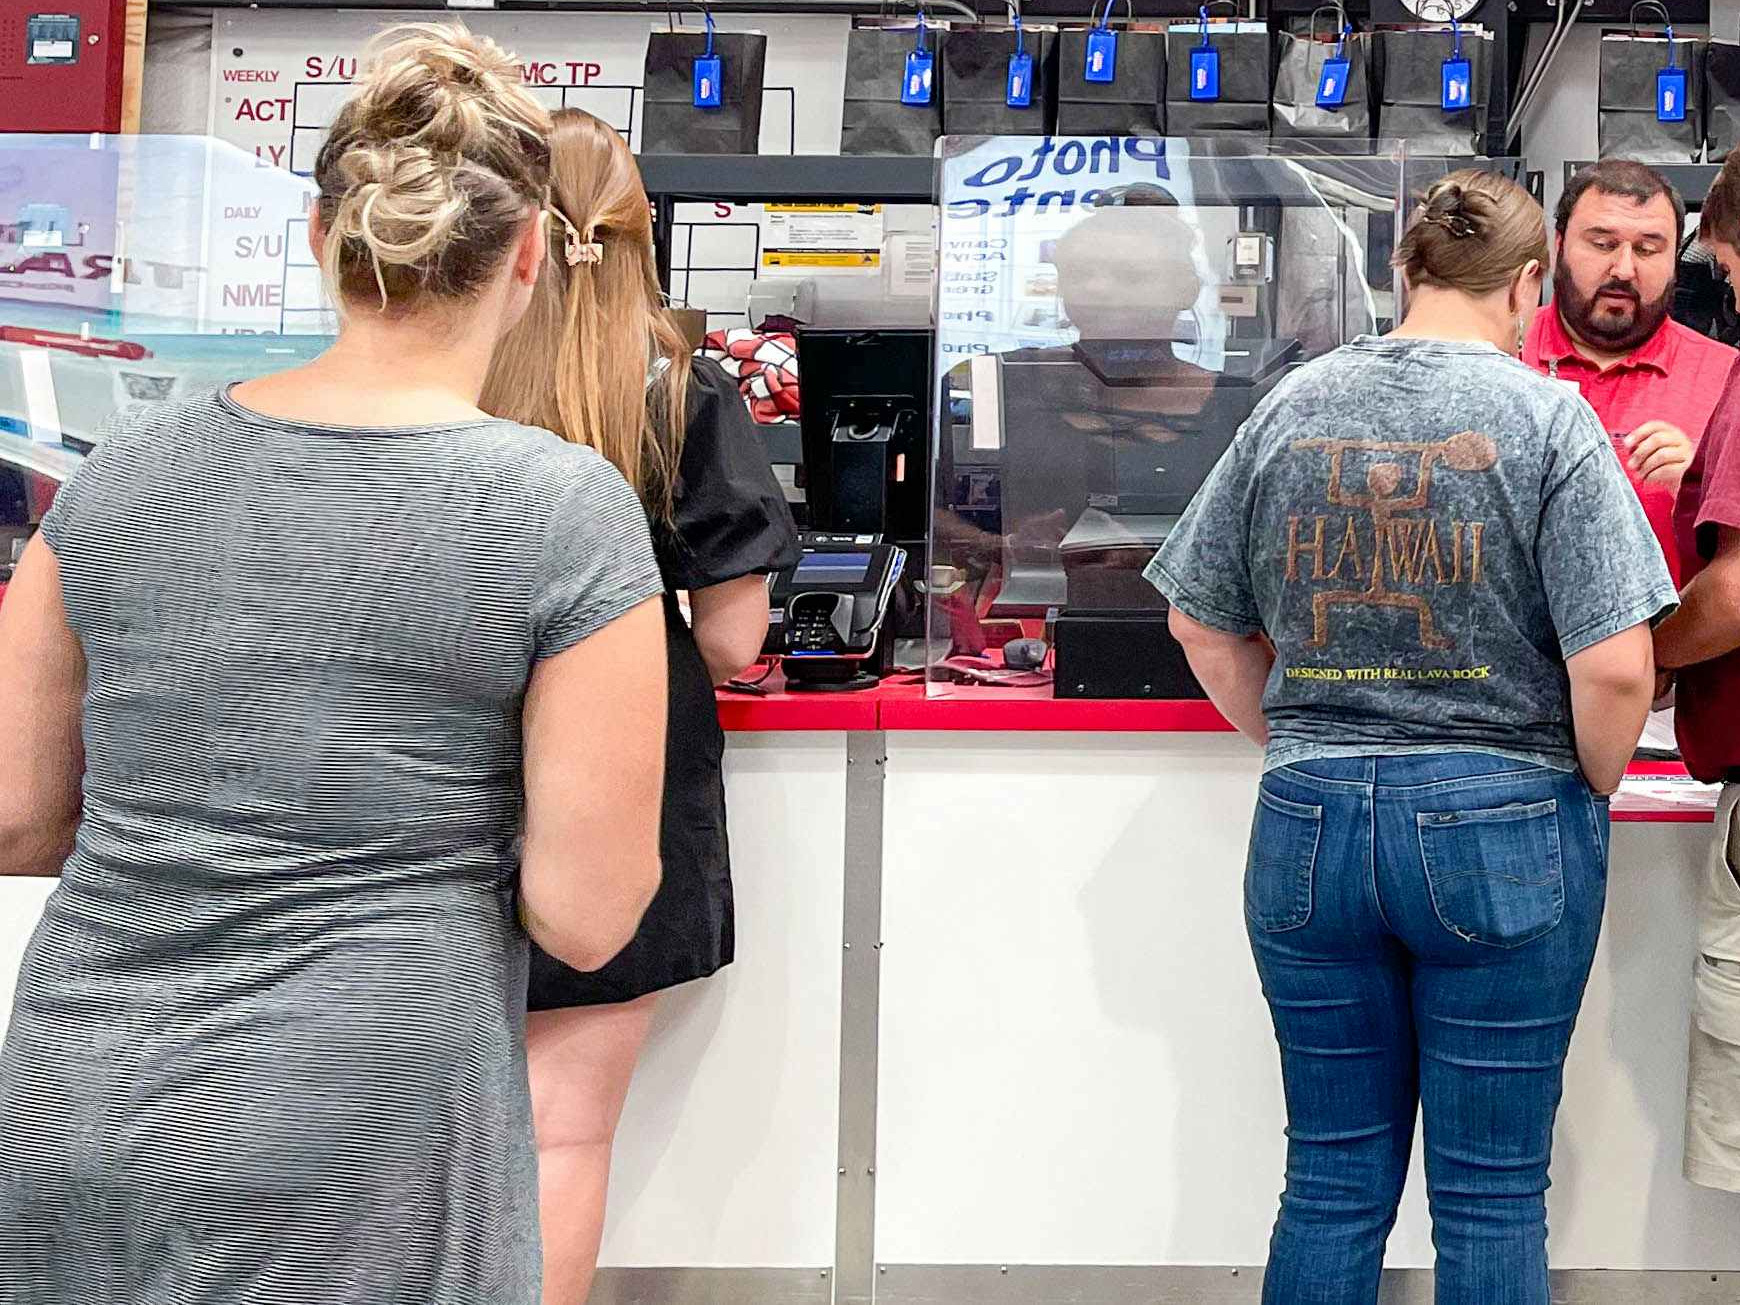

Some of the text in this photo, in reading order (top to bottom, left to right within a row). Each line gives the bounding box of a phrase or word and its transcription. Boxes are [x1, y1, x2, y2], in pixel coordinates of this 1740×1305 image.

[222, 69, 280, 83] WEEKLY
[565, 62, 601, 85] TP
[235, 98, 293, 122] ACT
[224, 206, 262, 220] DAILY
[234, 234, 283, 259] S/U
[222, 283, 282, 308] NME
[1285, 665, 1490, 681] DESIGNED WITH REAL LAVA ROCK
